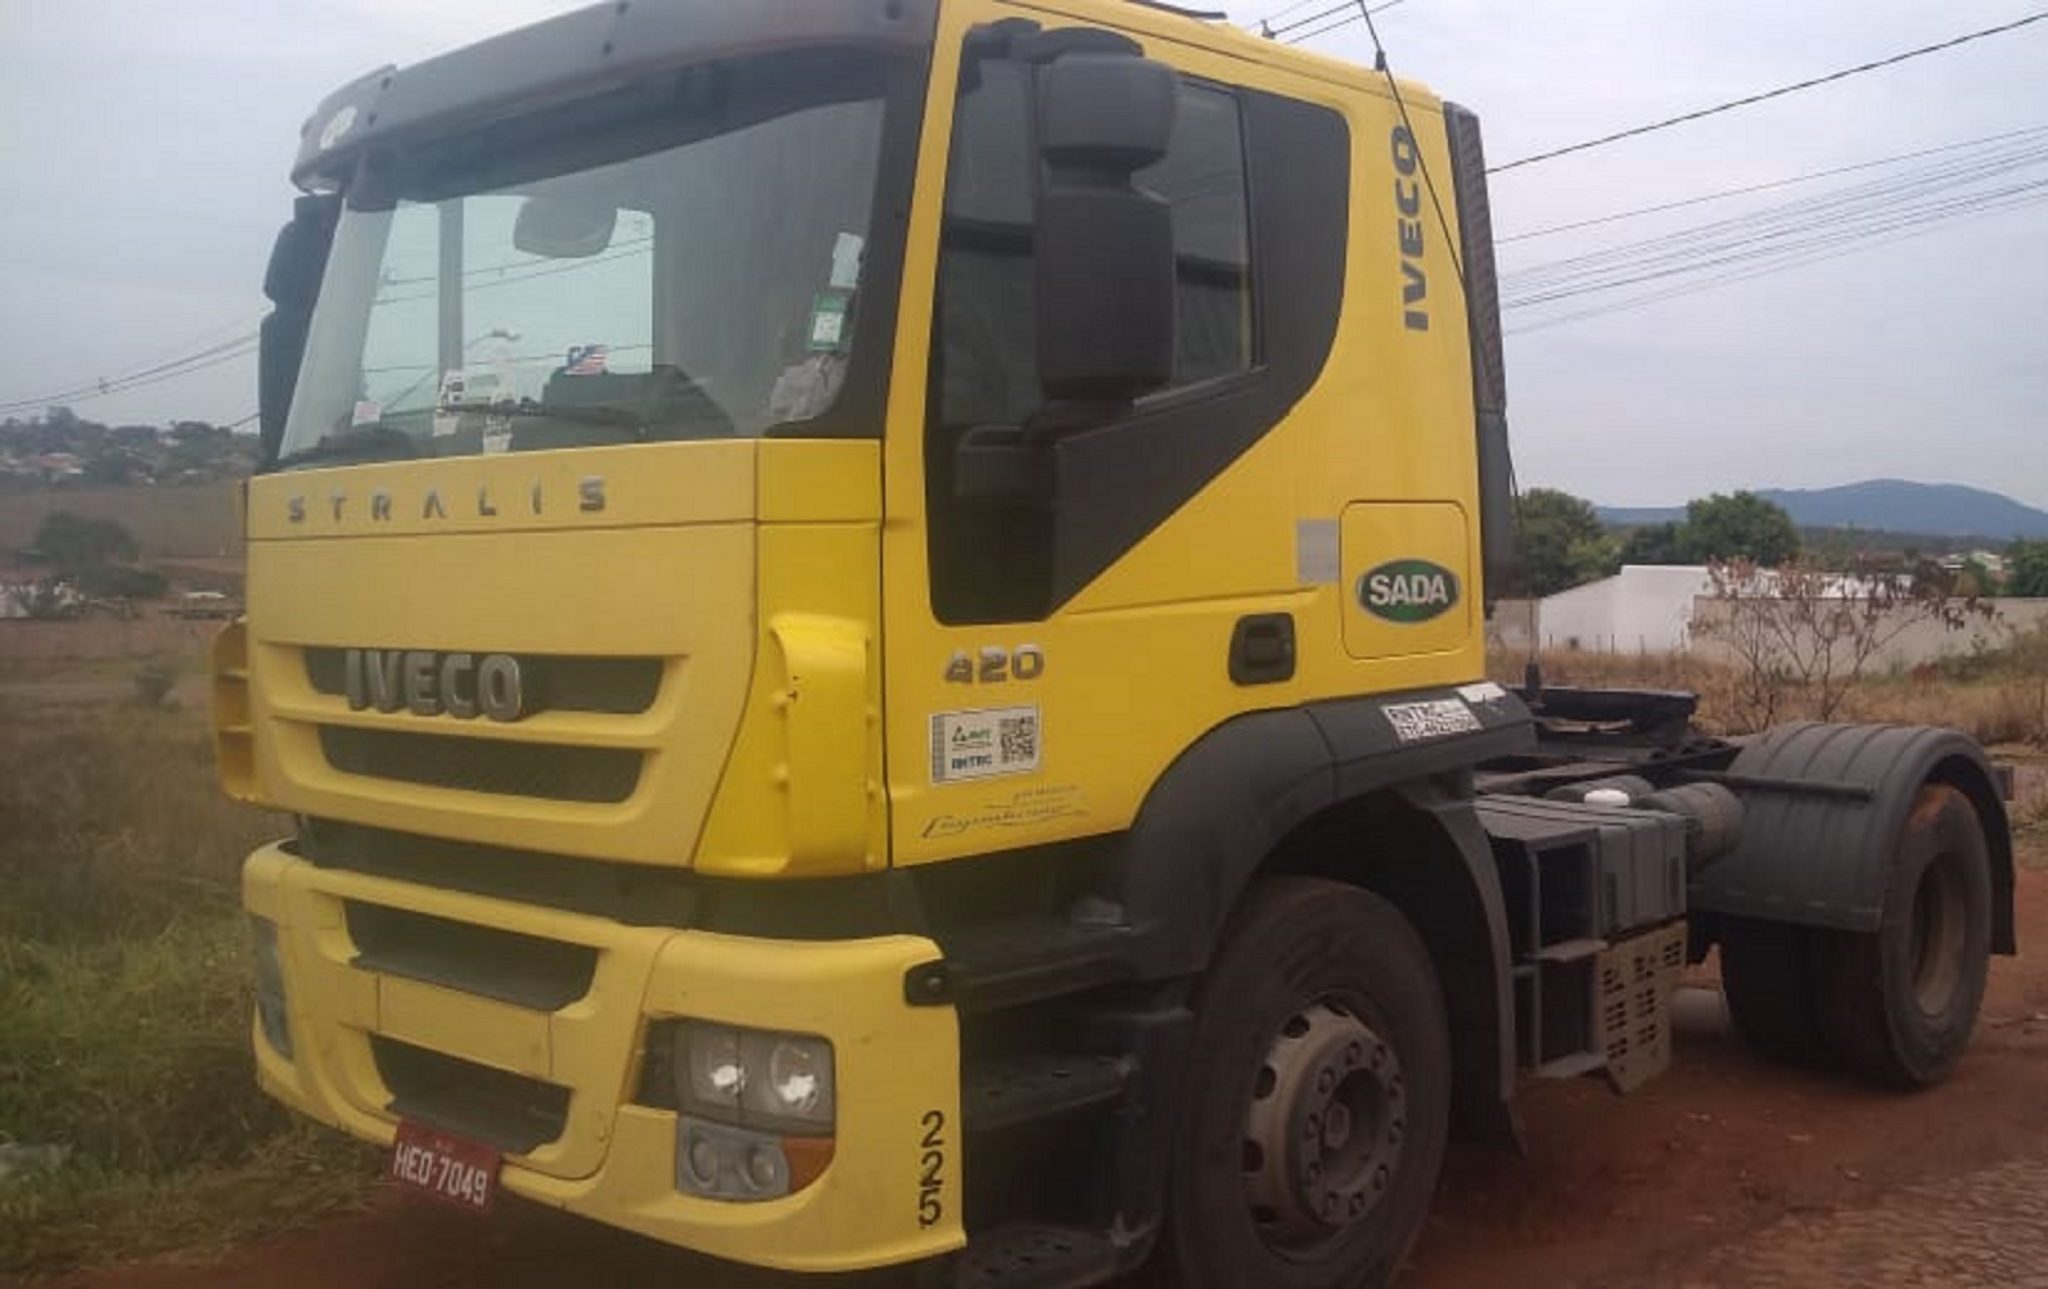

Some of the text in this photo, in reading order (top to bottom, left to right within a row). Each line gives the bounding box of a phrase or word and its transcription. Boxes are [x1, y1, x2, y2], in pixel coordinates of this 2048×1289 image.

[1391, 125, 1428, 331] IVECO
[288, 475, 608, 524] STRALIS
[1369, 573, 1449, 606] SADA
[345, 648, 524, 722] IVECO
[944, 643, 1045, 684] 420
